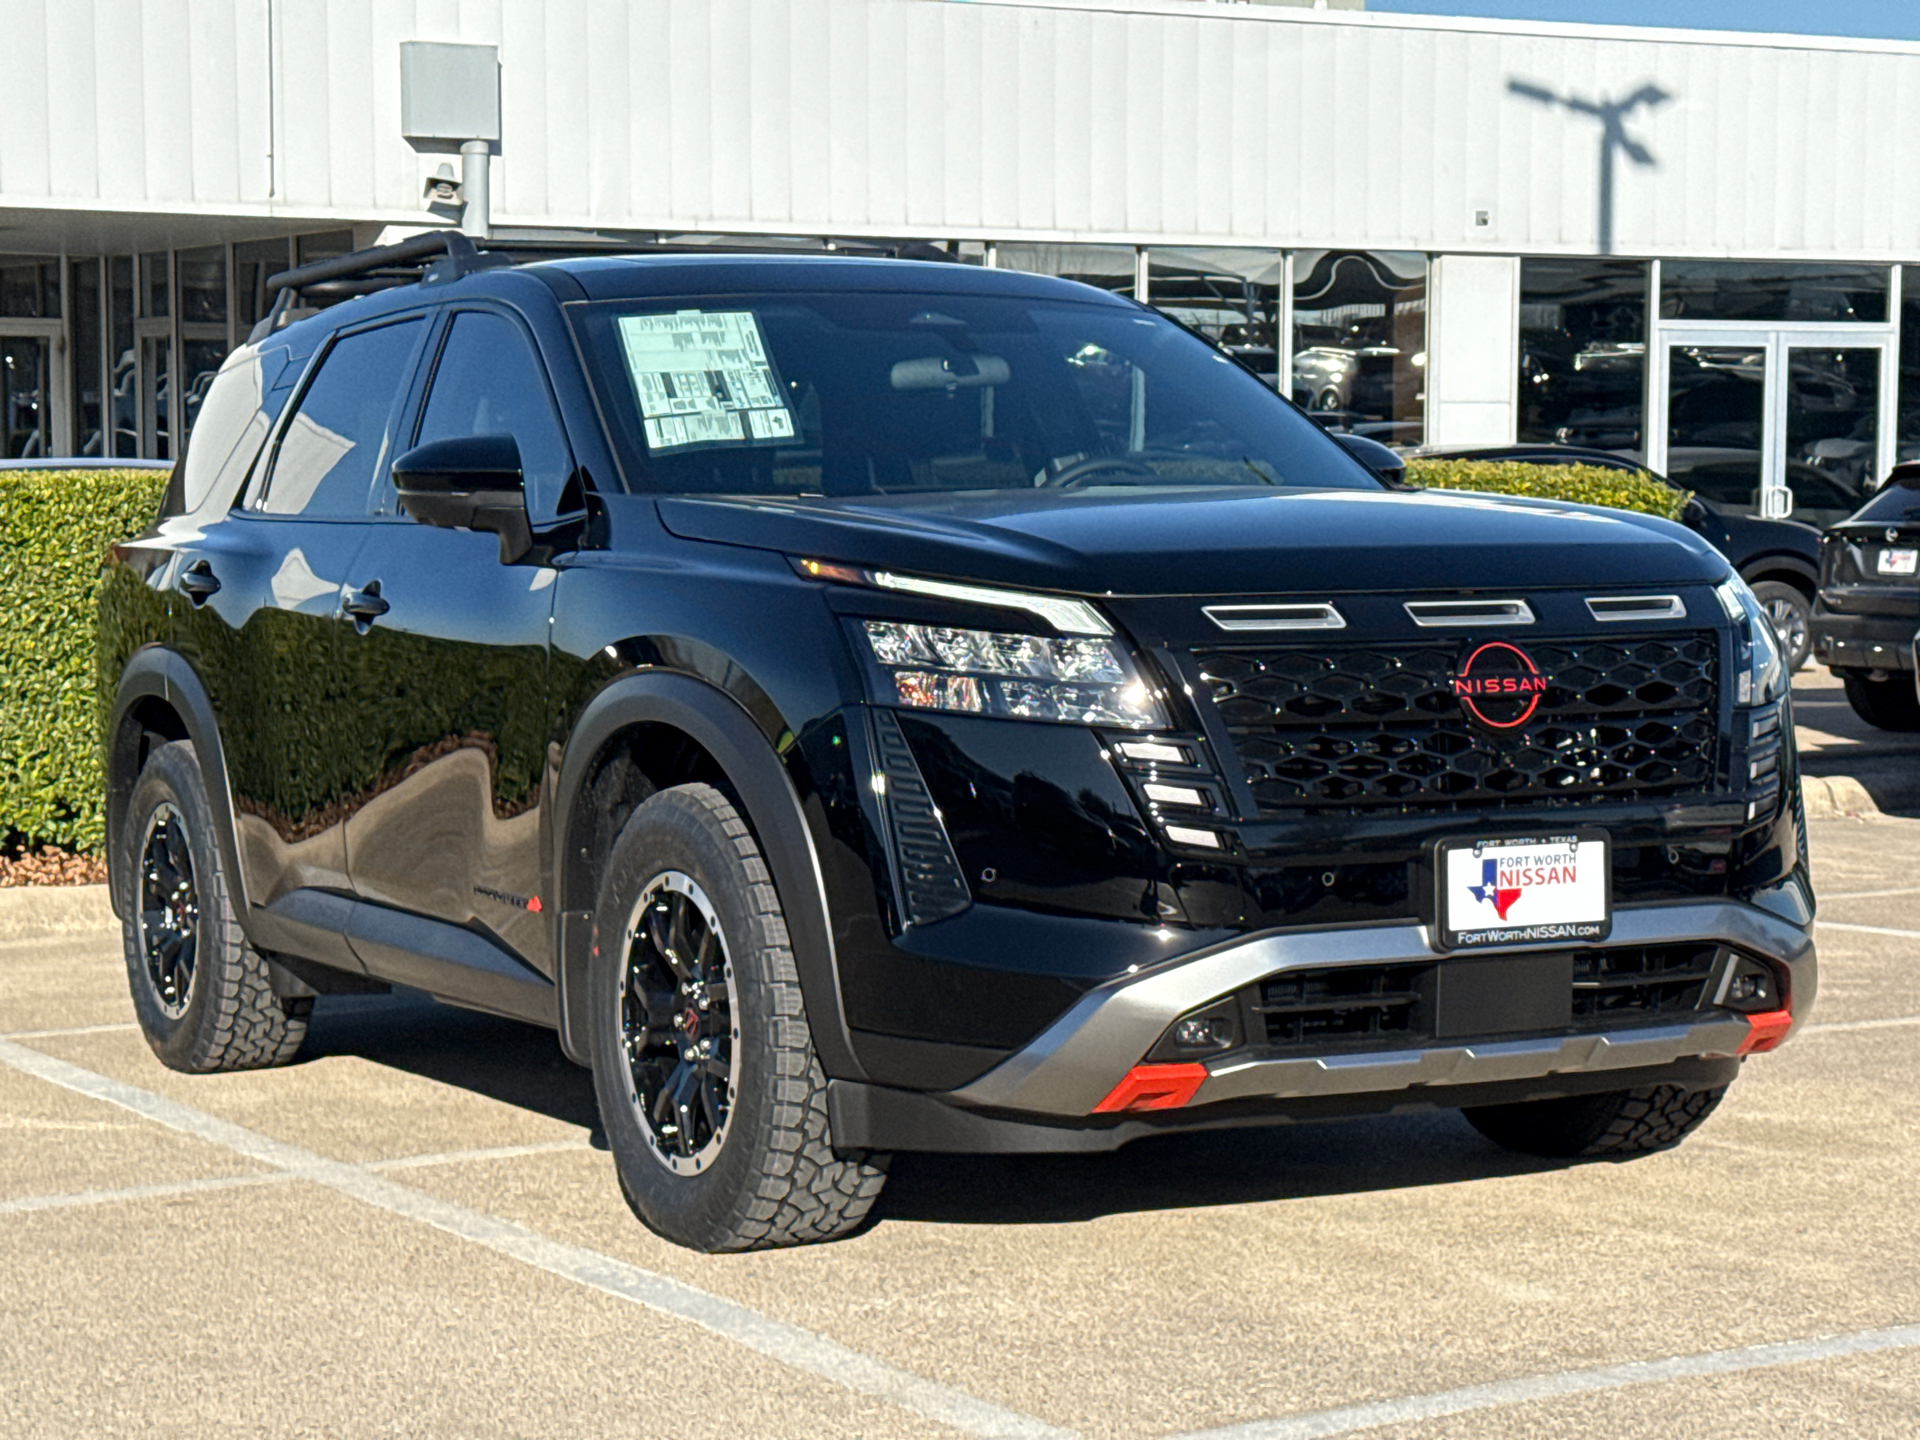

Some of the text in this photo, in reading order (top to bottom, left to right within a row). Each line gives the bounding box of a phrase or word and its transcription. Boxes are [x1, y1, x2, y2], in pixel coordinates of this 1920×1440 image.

[1454, 677, 1547, 694] NISSAN
[1477, 835, 1578, 848] FORT WORTH TEXAS
[1499, 853, 1577, 868] FORT WORTH
[1499, 865, 1577, 887] NISSAN
